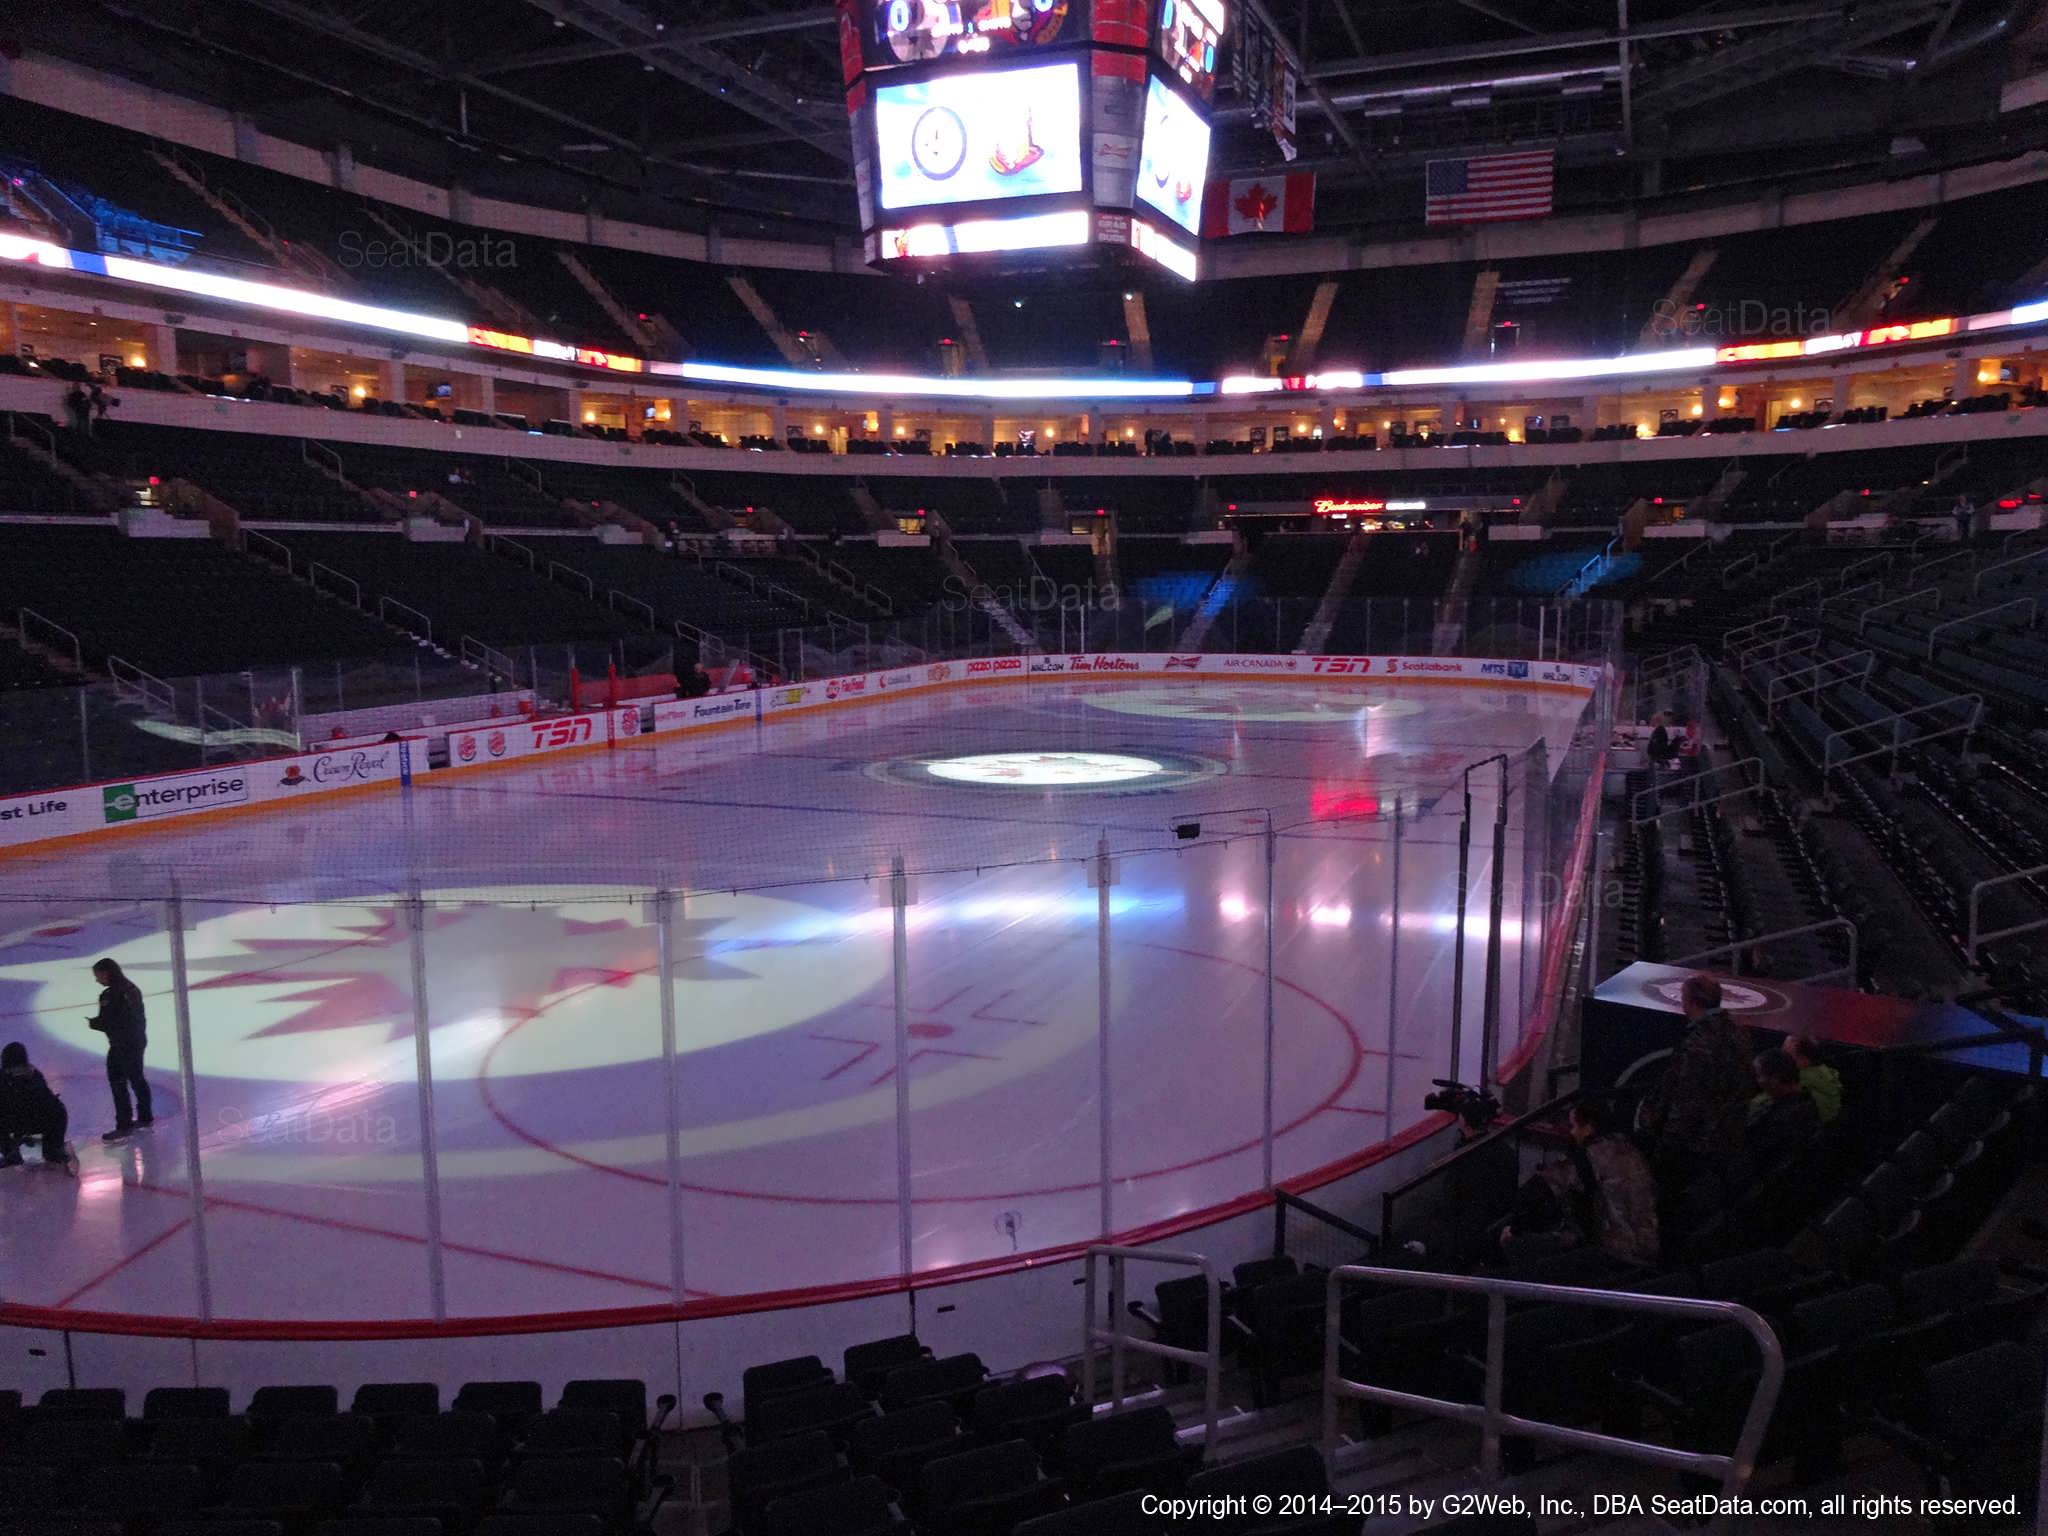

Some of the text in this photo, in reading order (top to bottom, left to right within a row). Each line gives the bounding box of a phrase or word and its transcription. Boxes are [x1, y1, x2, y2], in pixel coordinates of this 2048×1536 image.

[1070, 655, 1140, 671] Tim Hortons
[1242, 659, 1284, 668] CANADA
[1311, 657, 1371, 673] TSN
[1402, 661, 1463, 672] Scotiabank
[1481, 663, 1505, 675] MTS
[694, 703, 734, 718] Fountain
[734, 698, 751, 711] Tire
[531, 717, 592, 749] TSN
[28, 800, 68, 816] Life
